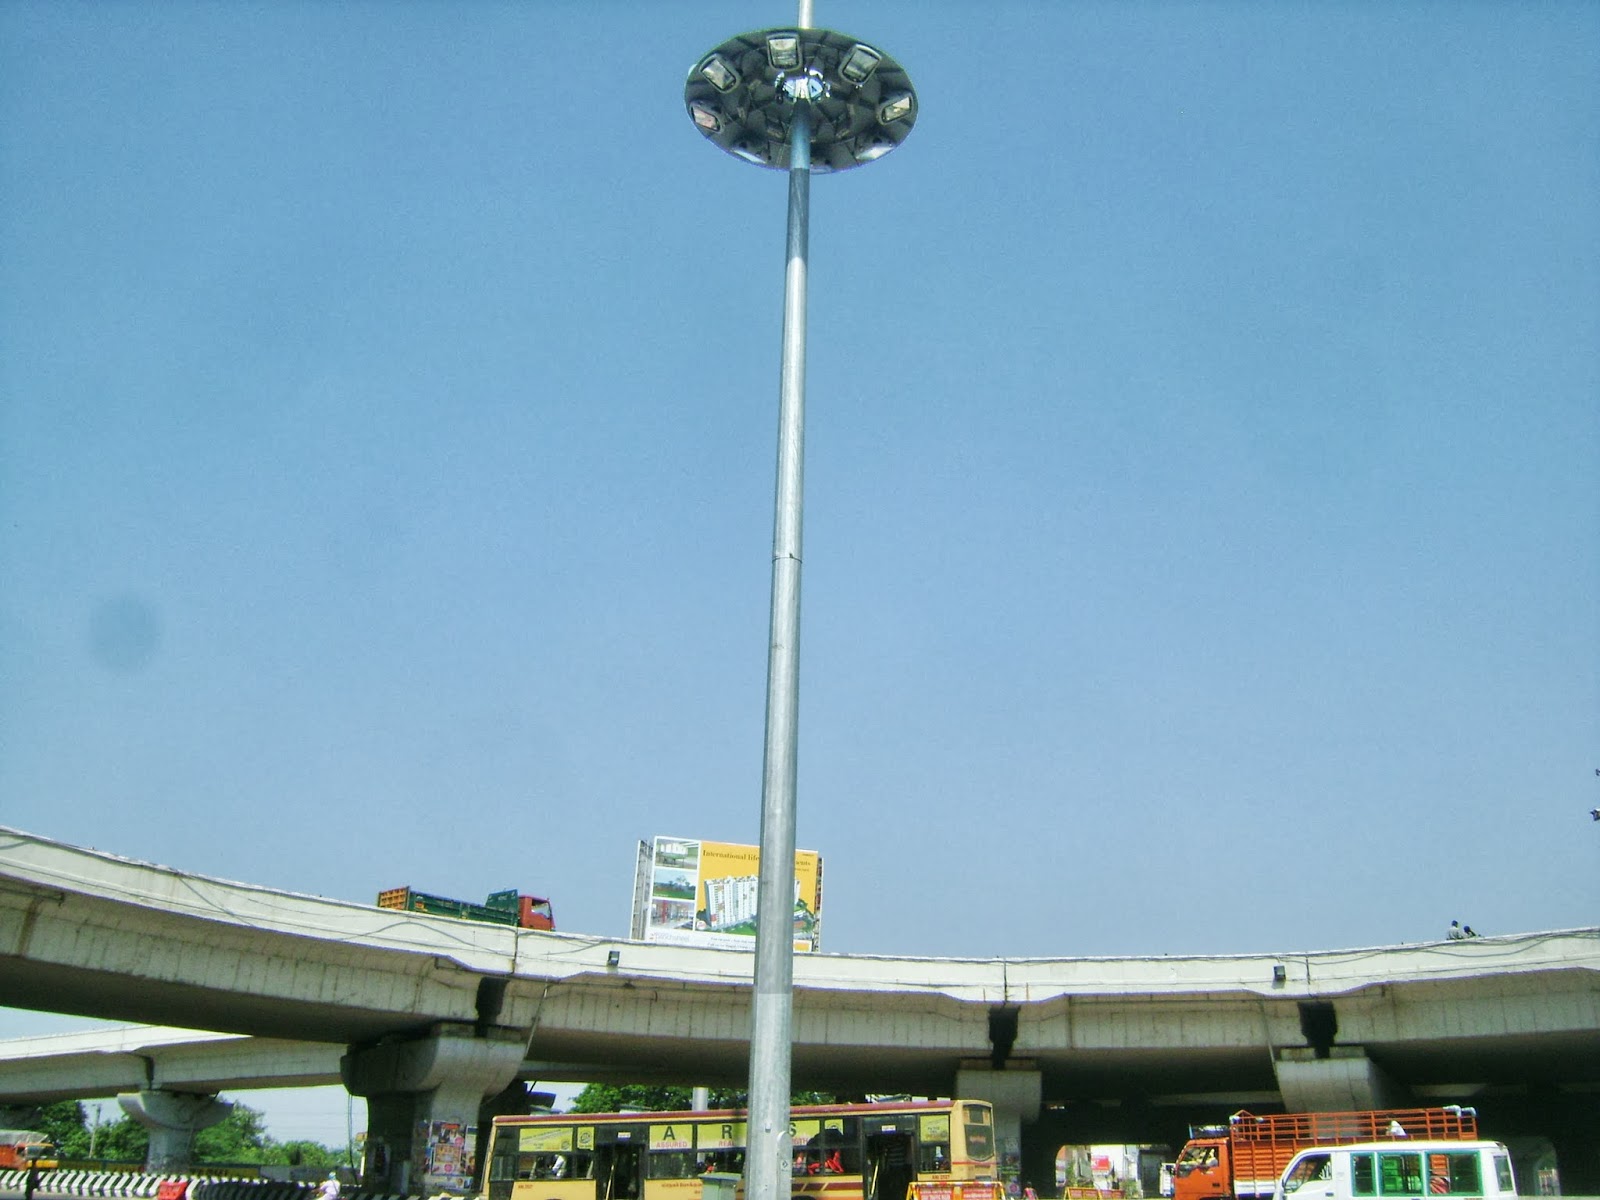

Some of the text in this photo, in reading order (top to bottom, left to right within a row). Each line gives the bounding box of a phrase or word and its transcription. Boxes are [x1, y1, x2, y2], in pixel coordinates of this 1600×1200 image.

[702, 849, 746, 860] International
[663, 1126, 675, 1140] A
[722, 1125, 732, 1139] R
